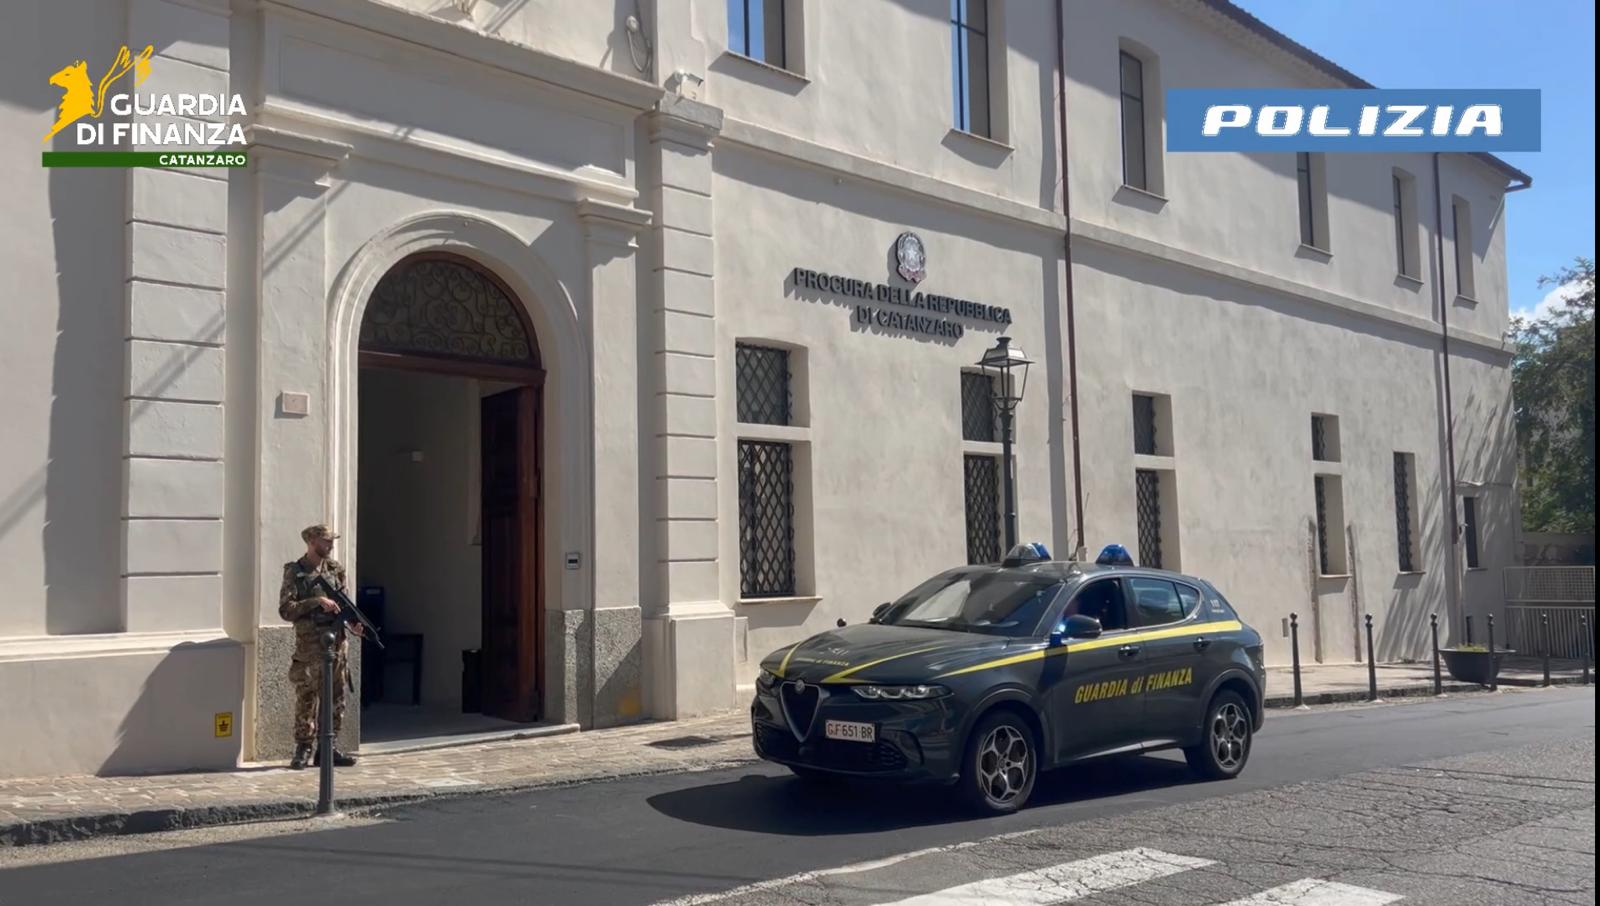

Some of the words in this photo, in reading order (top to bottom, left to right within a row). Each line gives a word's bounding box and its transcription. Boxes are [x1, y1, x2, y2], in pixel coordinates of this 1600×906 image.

[793, 267, 873, 300] PROCURA
[877, 284, 927, 310] DELLA
[927, 295, 1012, 324] REPUBBLICA
[856, 305, 873, 324] DI
[876, 310, 964, 339] CATANZARO
[1074, 679, 1128, 704] GUARDIA
[1131, 678, 1145, 693] di
[1146, 667, 1193, 692] FINANZA
[841, 724, 858, 738] 651
[861, 726, 873, 739] BR
